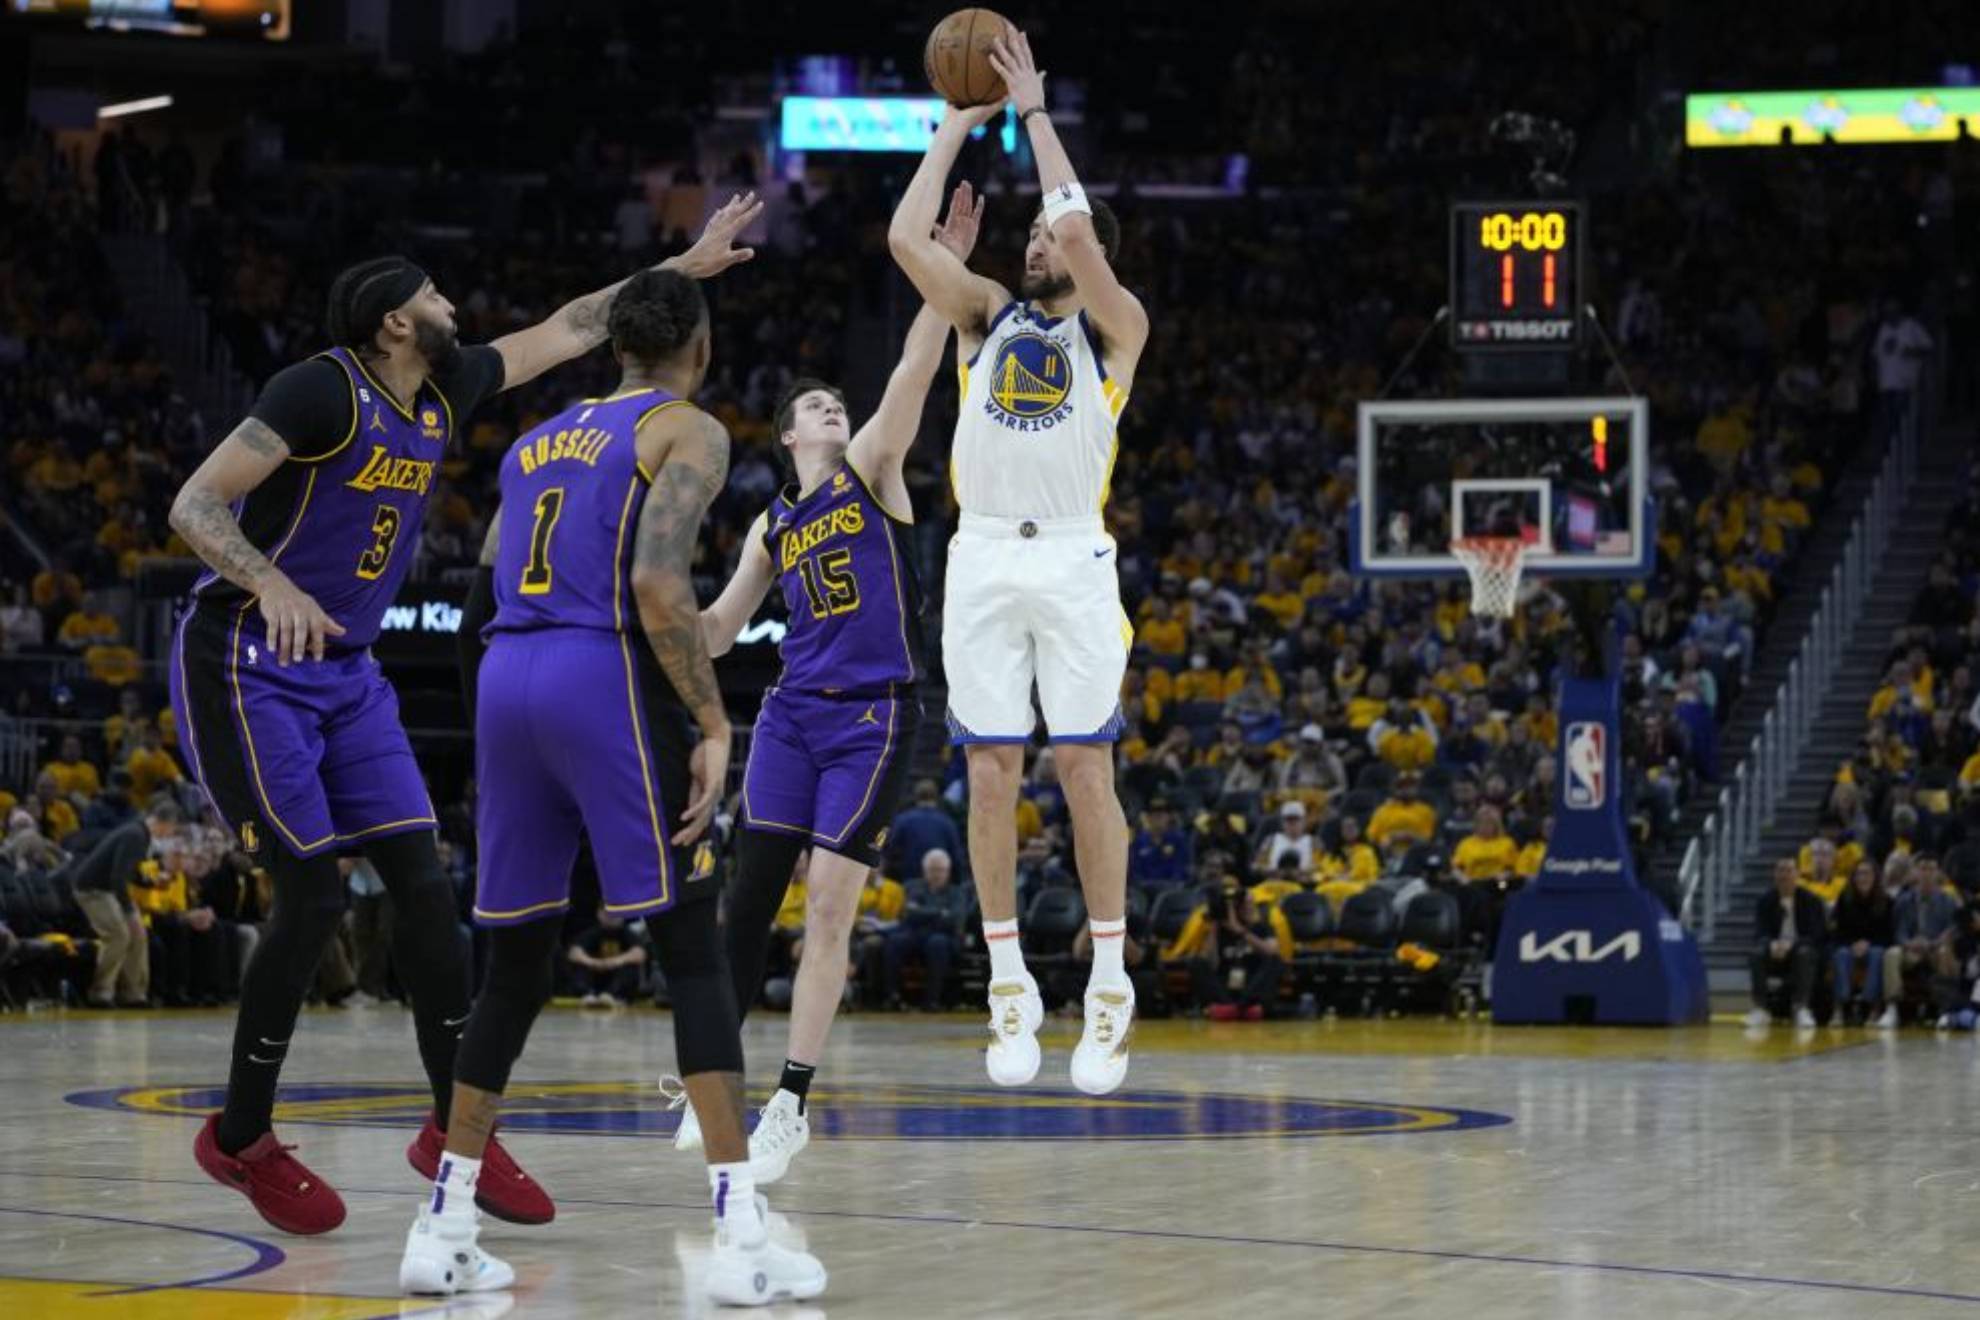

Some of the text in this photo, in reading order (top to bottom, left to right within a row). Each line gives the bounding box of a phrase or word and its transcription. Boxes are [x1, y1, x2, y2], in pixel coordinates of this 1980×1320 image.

[1481, 213, 1565, 250] 10:00
[1502, 253, 1555, 308] 11
[1489, 321, 1573, 339] TISSOT
[1045, 355, 1057, 378] 11
[984, 399, 1073, 431] WARRIORS
[519, 428, 613, 475] RUSSELL
[356, 504, 400, 580] 3
[518, 486, 564, 594] 1
[781, 502, 864, 571] LAKERS
[800, 547, 860, 619] 15
[1519, 930, 1641, 962] KIA
